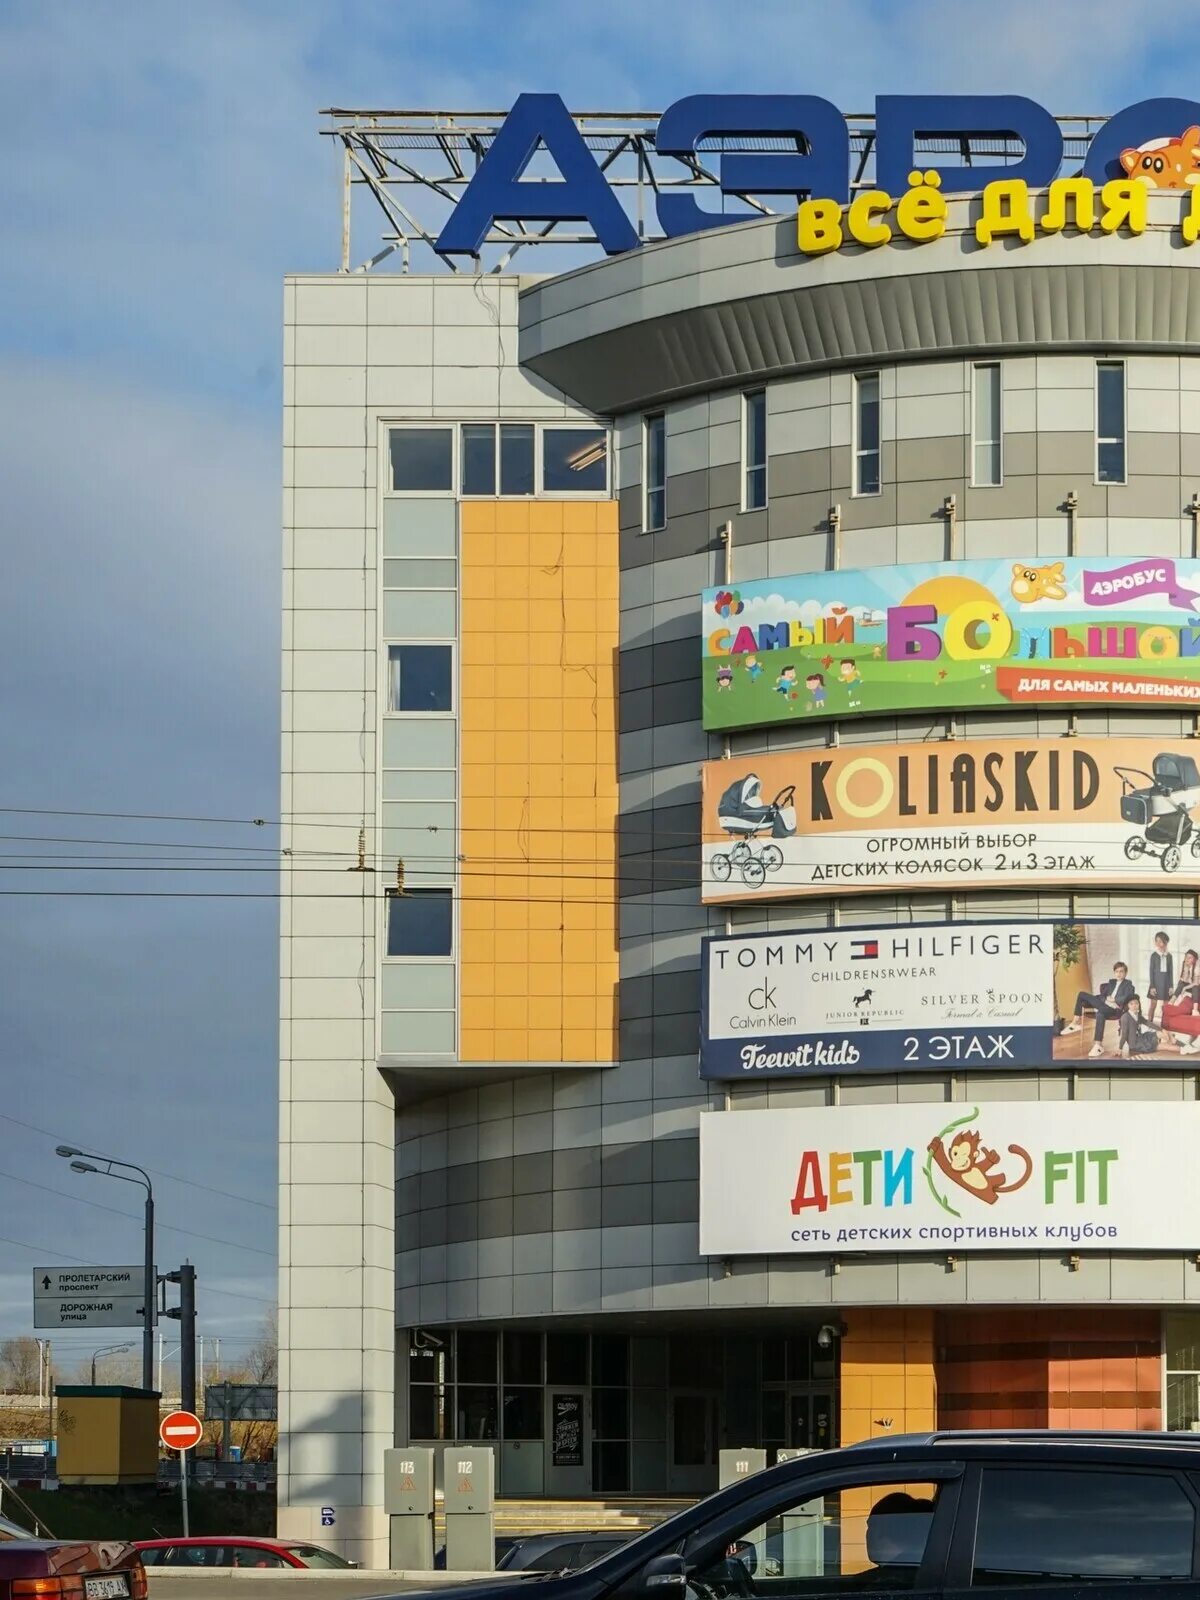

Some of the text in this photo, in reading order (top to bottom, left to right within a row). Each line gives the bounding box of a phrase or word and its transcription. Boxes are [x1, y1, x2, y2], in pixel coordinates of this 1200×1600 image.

[798, 170, 949, 255] всё
[976, 178, 1148, 248] для
[1090, 568, 1167, 596] АЭРОБУС
[707, 606, 855, 657] САМЫЙ
[1017, 678, 1051, 693] ДЛЯ
[1053, 679, 1110, 694] САМЫХ
[811, 750, 1100, 821] KOLIASKID
[866, 831, 1038, 853] ОГРОМНЫЙ ВЫБОР
[811, 861, 889, 881] ДЕТСКИХ
[895, 857, 984, 875] КОЛЯСОК
[995, 853, 1007, 871] 2
[1026, 853, 1038, 870] 3
[1044, 855, 1096, 870] ЭТАЖ
[714, 934, 1044, 970] TOMMY HILFIGER
[811, 966, 937, 983] CHILDRENSRWEAR
[921, 993, 1044, 1006] SILVER SPOON
[729, 1013, 797, 1030] Calvin Klein
[814, 1040, 860, 1065] kids
[904, 1035, 1015, 1061] 2 ЭТАЖ
[790, 1147, 1120, 1215] ДЕТИ FIT
[791, 1222, 1118, 1243] сеть детских спортивных клубов
[59, 1272, 131, 1283] ПРОЛЕТАРСКИЙ
[59, 1284, 99, 1293] проспект
[60, 1303, 113, 1313] ДОРОЖНАЯ
[60, 1313, 87, 1322] улица
[400, 1461, 415, 1474] 113
[457, 1461, 473, 1474] 112
[736, 1461, 749, 1473] 111
